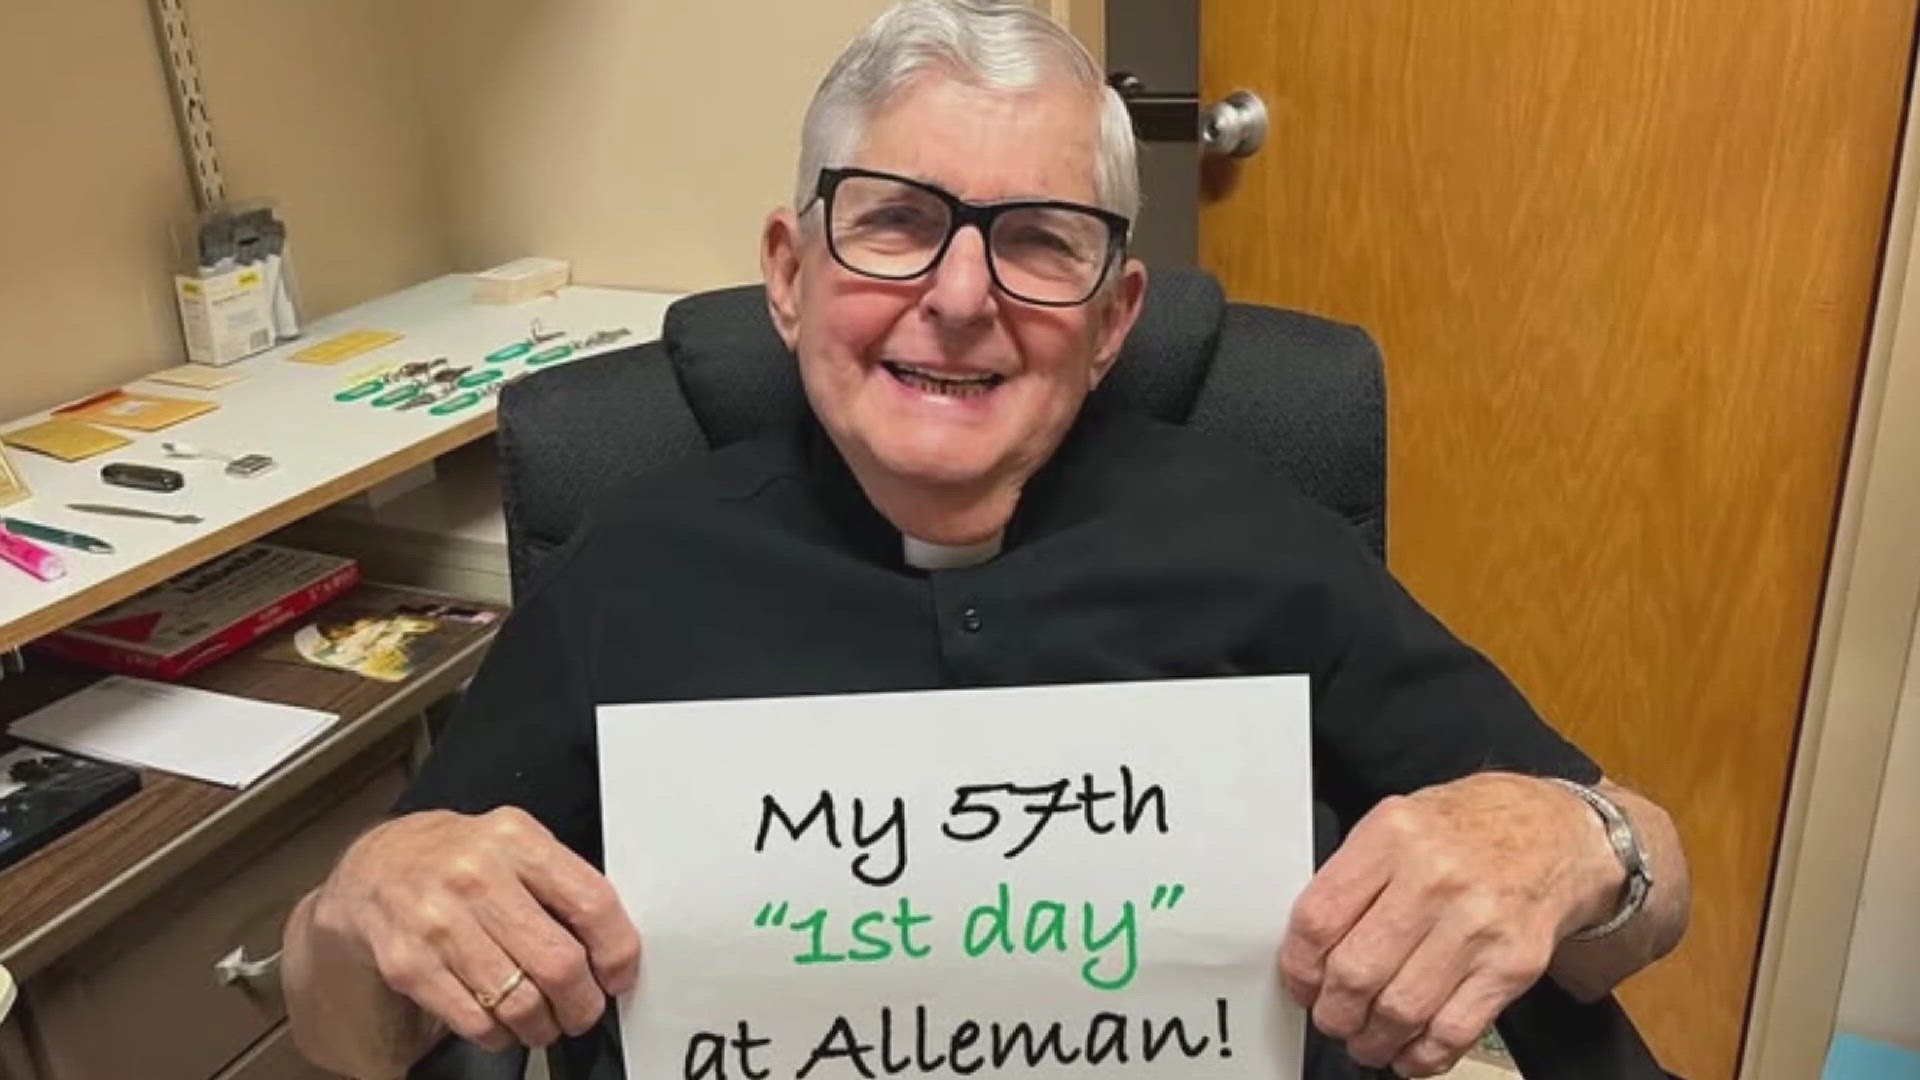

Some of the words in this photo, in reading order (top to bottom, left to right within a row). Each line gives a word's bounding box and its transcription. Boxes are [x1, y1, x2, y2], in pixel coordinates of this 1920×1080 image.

[754, 790, 909, 887] My
[942, 765, 1170, 859] 57th
[755, 897, 932, 966] “1st
[964, 883, 1184, 991] day”
[684, 1020, 773, 1080] at
[795, 997, 1234, 1080] Alleman!
